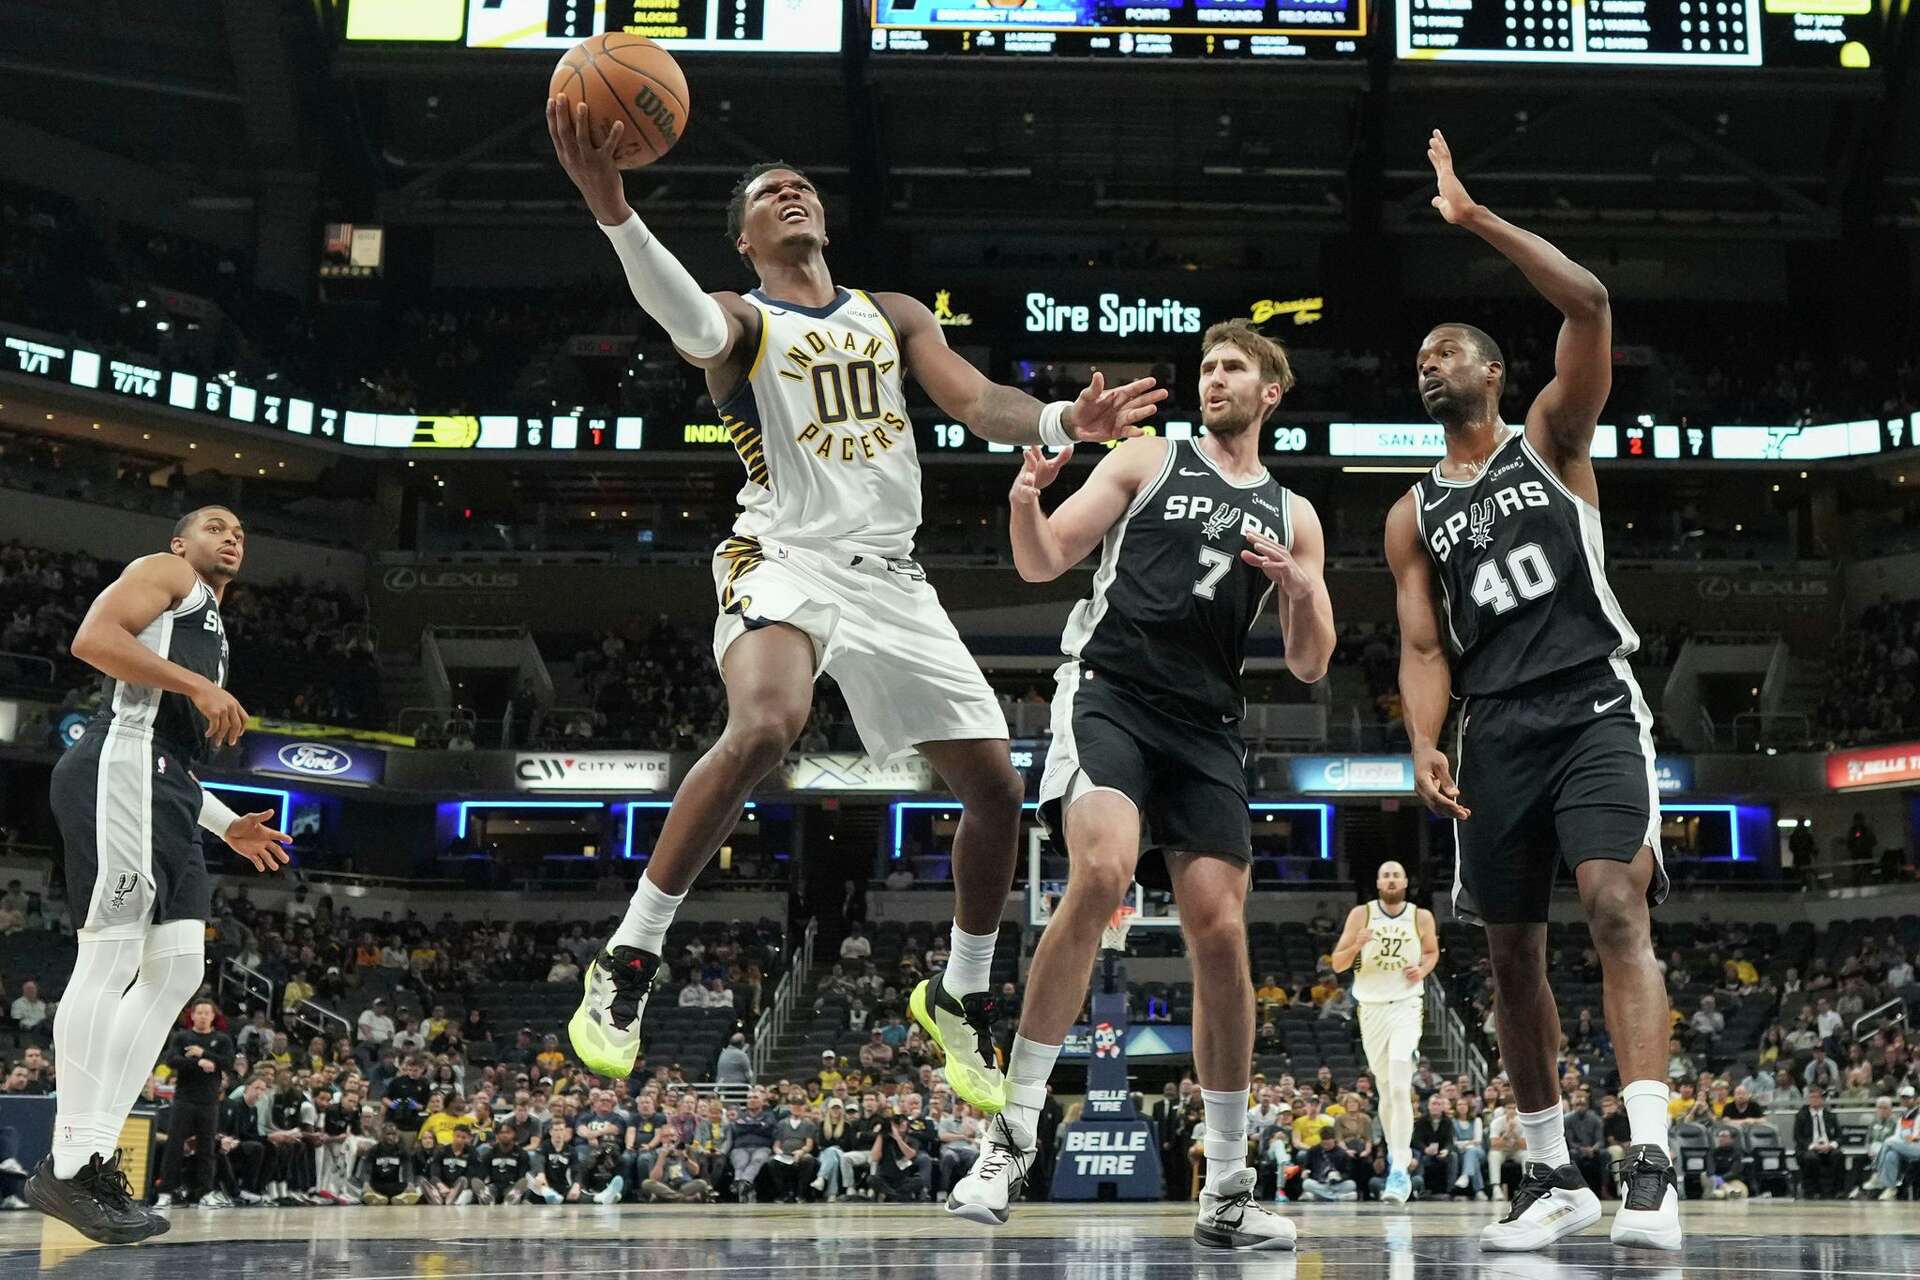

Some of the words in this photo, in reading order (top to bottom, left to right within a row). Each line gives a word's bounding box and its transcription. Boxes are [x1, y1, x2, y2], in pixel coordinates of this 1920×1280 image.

[1026, 293, 1089, 332] Sire
[1099, 294, 1201, 337] Spirits
[780, 331, 895, 381] INDIANA
[112, 371, 157, 398] 7/14
[812, 360, 880, 424] 00
[592, 428, 603, 446] 1
[684, 425, 731, 442] INDIA
[797, 412, 905, 461] PACERS
[934, 424, 965, 447] 19
[1274, 428, 1307, 450] 20
[1378, 433, 1415, 446] SAN
[1630, 437, 1642, 454] 2
[1431, 481, 1550, 562] SPURS
[420, 570, 519, 587] LEXUS
[1192, 545, 1235, 601] 7
[1470, 541, 1557, 616] 40
[292, 746, 338, 770] Ford
[578, 762, 616, 771] CITY
[624, 762, 667, 772] WIDE
[1381, 937, 1402, 958] 32
[1087, 1090, 1127, 1101] BELLE
[1092, 1101, 1122, 1112] TIRE
[1065, 1131, 1148, 1151] BELLE
[1074, 1155, 1136, 1175] TIRE
